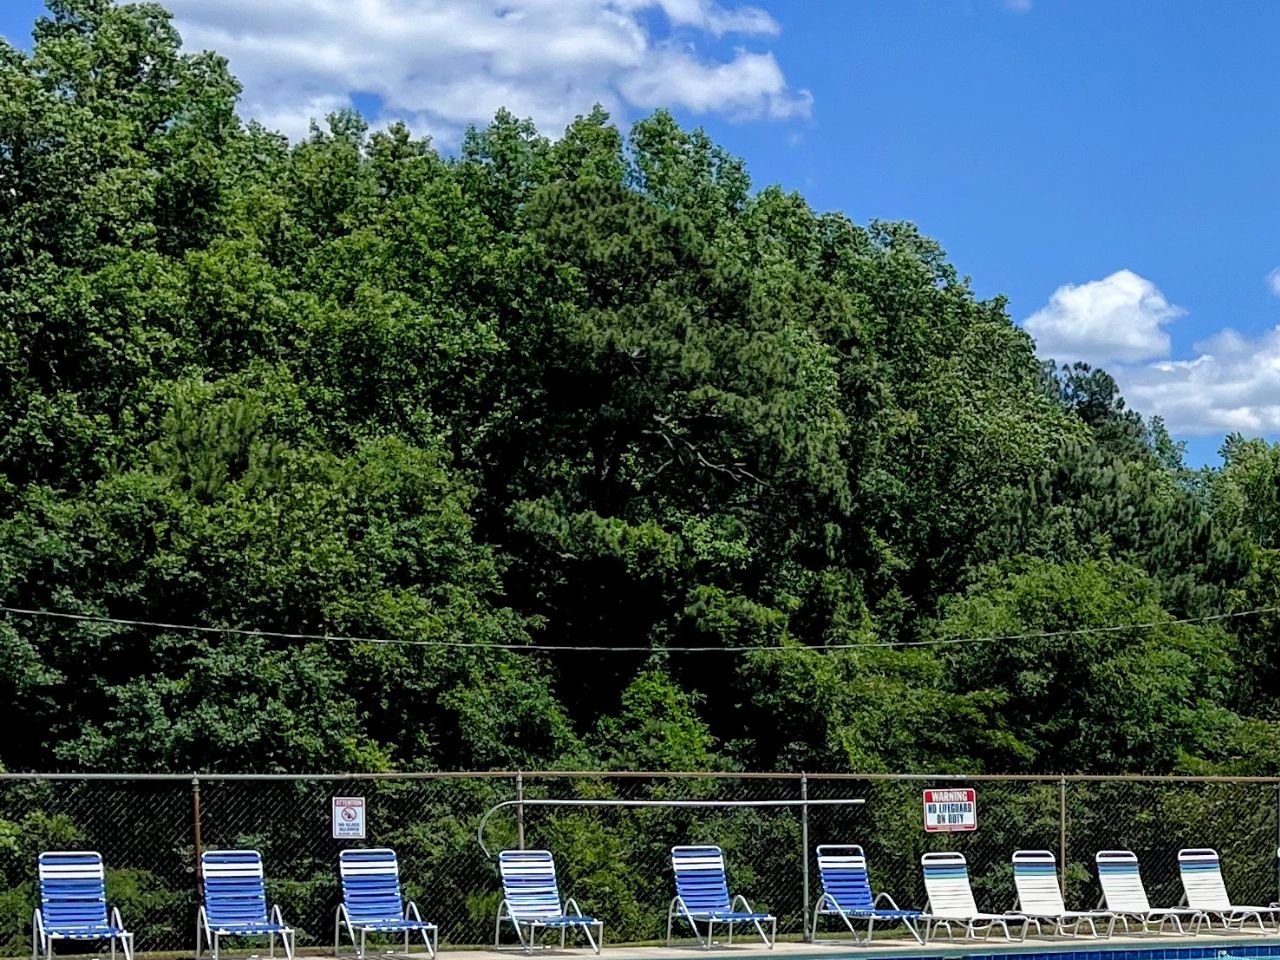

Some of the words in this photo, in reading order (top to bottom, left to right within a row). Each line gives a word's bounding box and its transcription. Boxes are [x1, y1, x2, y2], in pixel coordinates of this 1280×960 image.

[932, 790, 968, 802] WARNING
[928, 804, 937, 814] NO
[939, 803, 972, 813] LIFEGUARD
[937, 814, 946, 824] ON
[948, 814, 964, 824] DUTY
